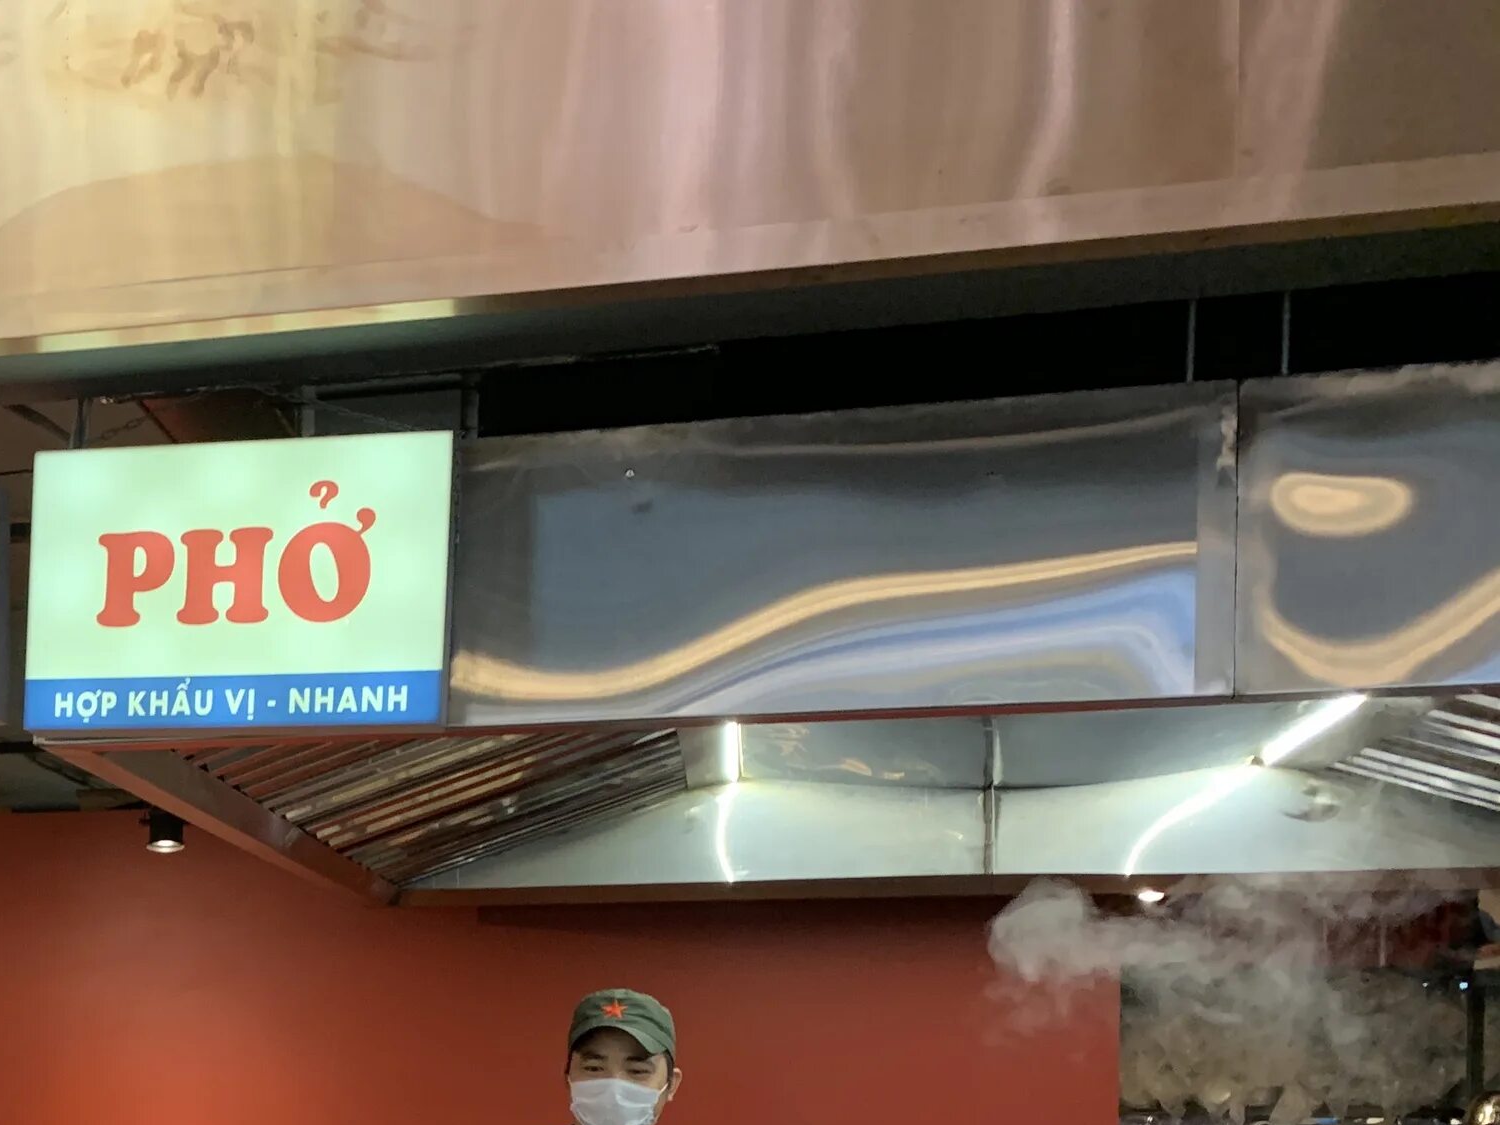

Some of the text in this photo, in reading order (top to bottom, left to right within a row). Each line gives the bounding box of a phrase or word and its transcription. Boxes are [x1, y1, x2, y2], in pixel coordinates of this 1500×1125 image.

[96, 479, 377, 628] PHỞ
[53, 689, 117, 723] HỢP
[127, 677, 213, 717] KHẨU
[225, 688, 255, 721] VỊ
[288, 685, 409, 715] NHANH
